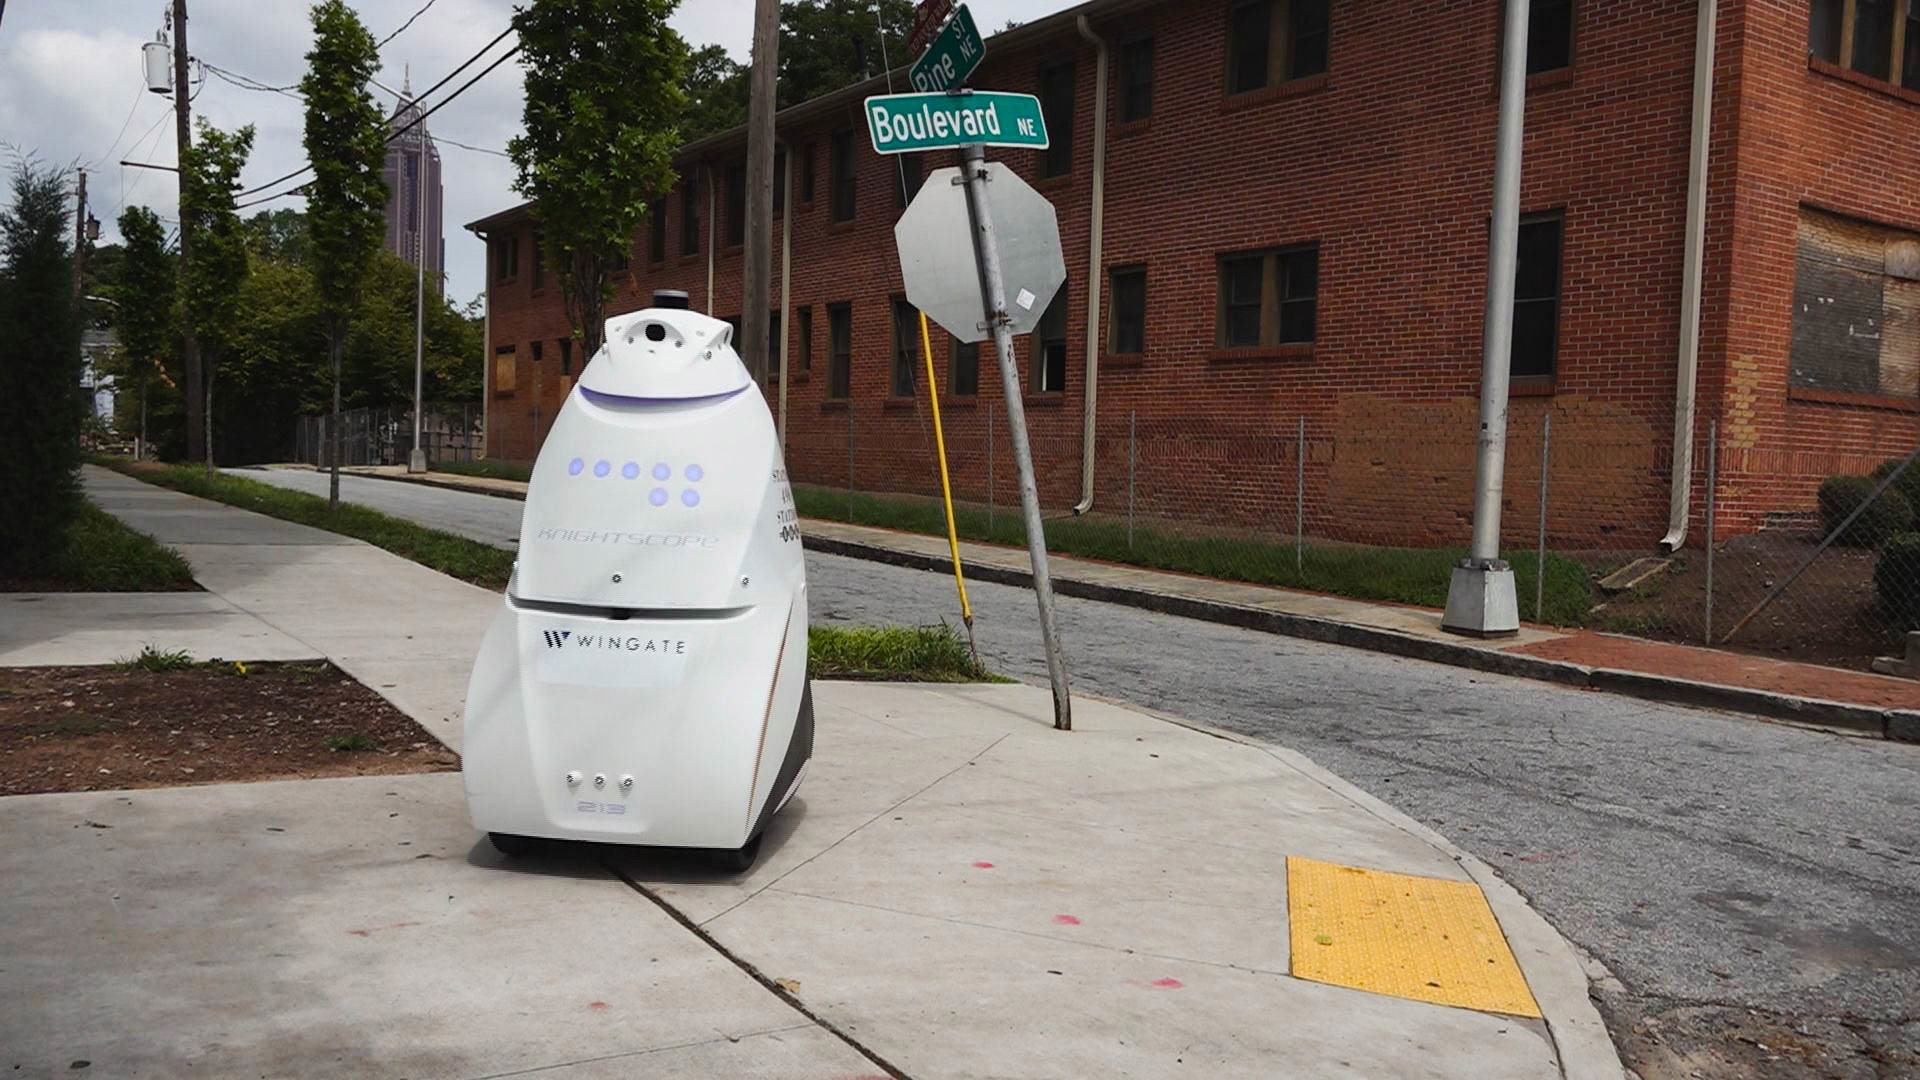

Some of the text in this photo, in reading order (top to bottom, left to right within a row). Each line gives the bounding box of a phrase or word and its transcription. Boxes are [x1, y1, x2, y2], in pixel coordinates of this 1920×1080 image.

[951, 13, 965, 39] ST
[960, 34, 976, 63] NE
[915, 53, 955, 92] Pine
[872, 102, 1037, 143] Boulevard NE
[577, 635, 686, 655] WINGATE
[577, 801, 625, 815] 213
